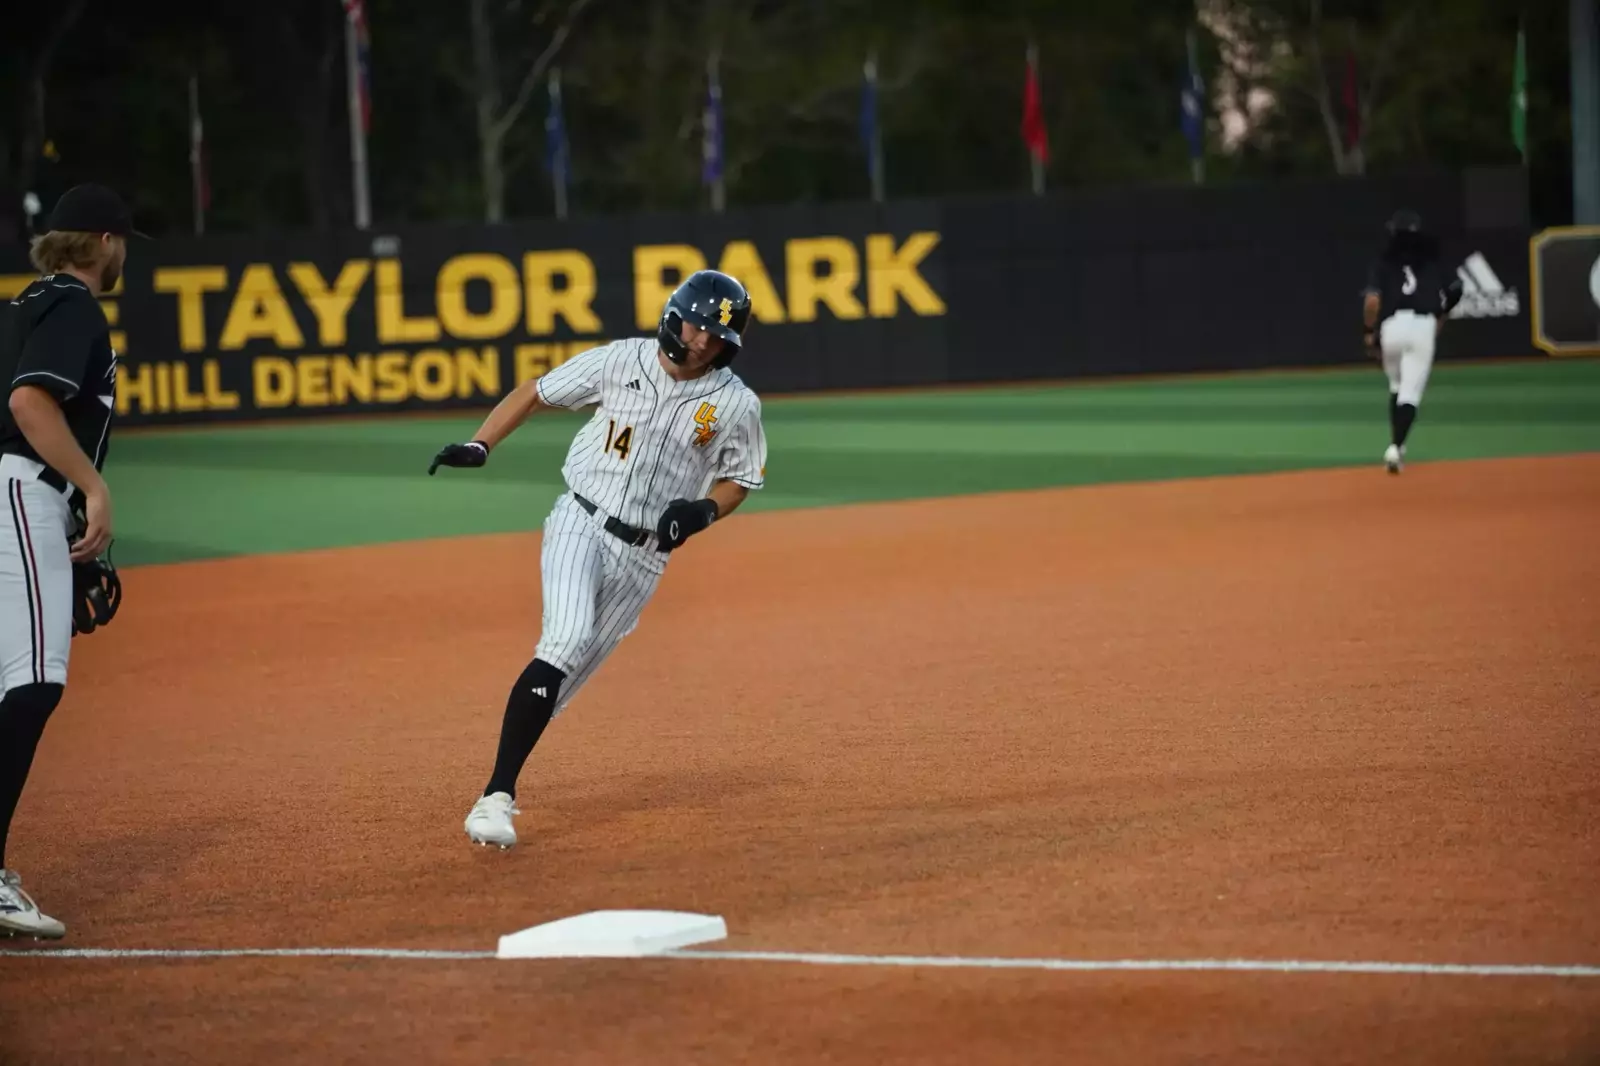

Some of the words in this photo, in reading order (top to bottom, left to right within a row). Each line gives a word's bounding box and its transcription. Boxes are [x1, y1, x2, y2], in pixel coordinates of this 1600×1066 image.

[153, 249, 602, 353] TAYLOR
[632, 231, 947, 331] PARK
[115, 360, 240, 417] HILL
[252, 346, 500, 408] DENSON
[604, 418, 634, 462] 14
